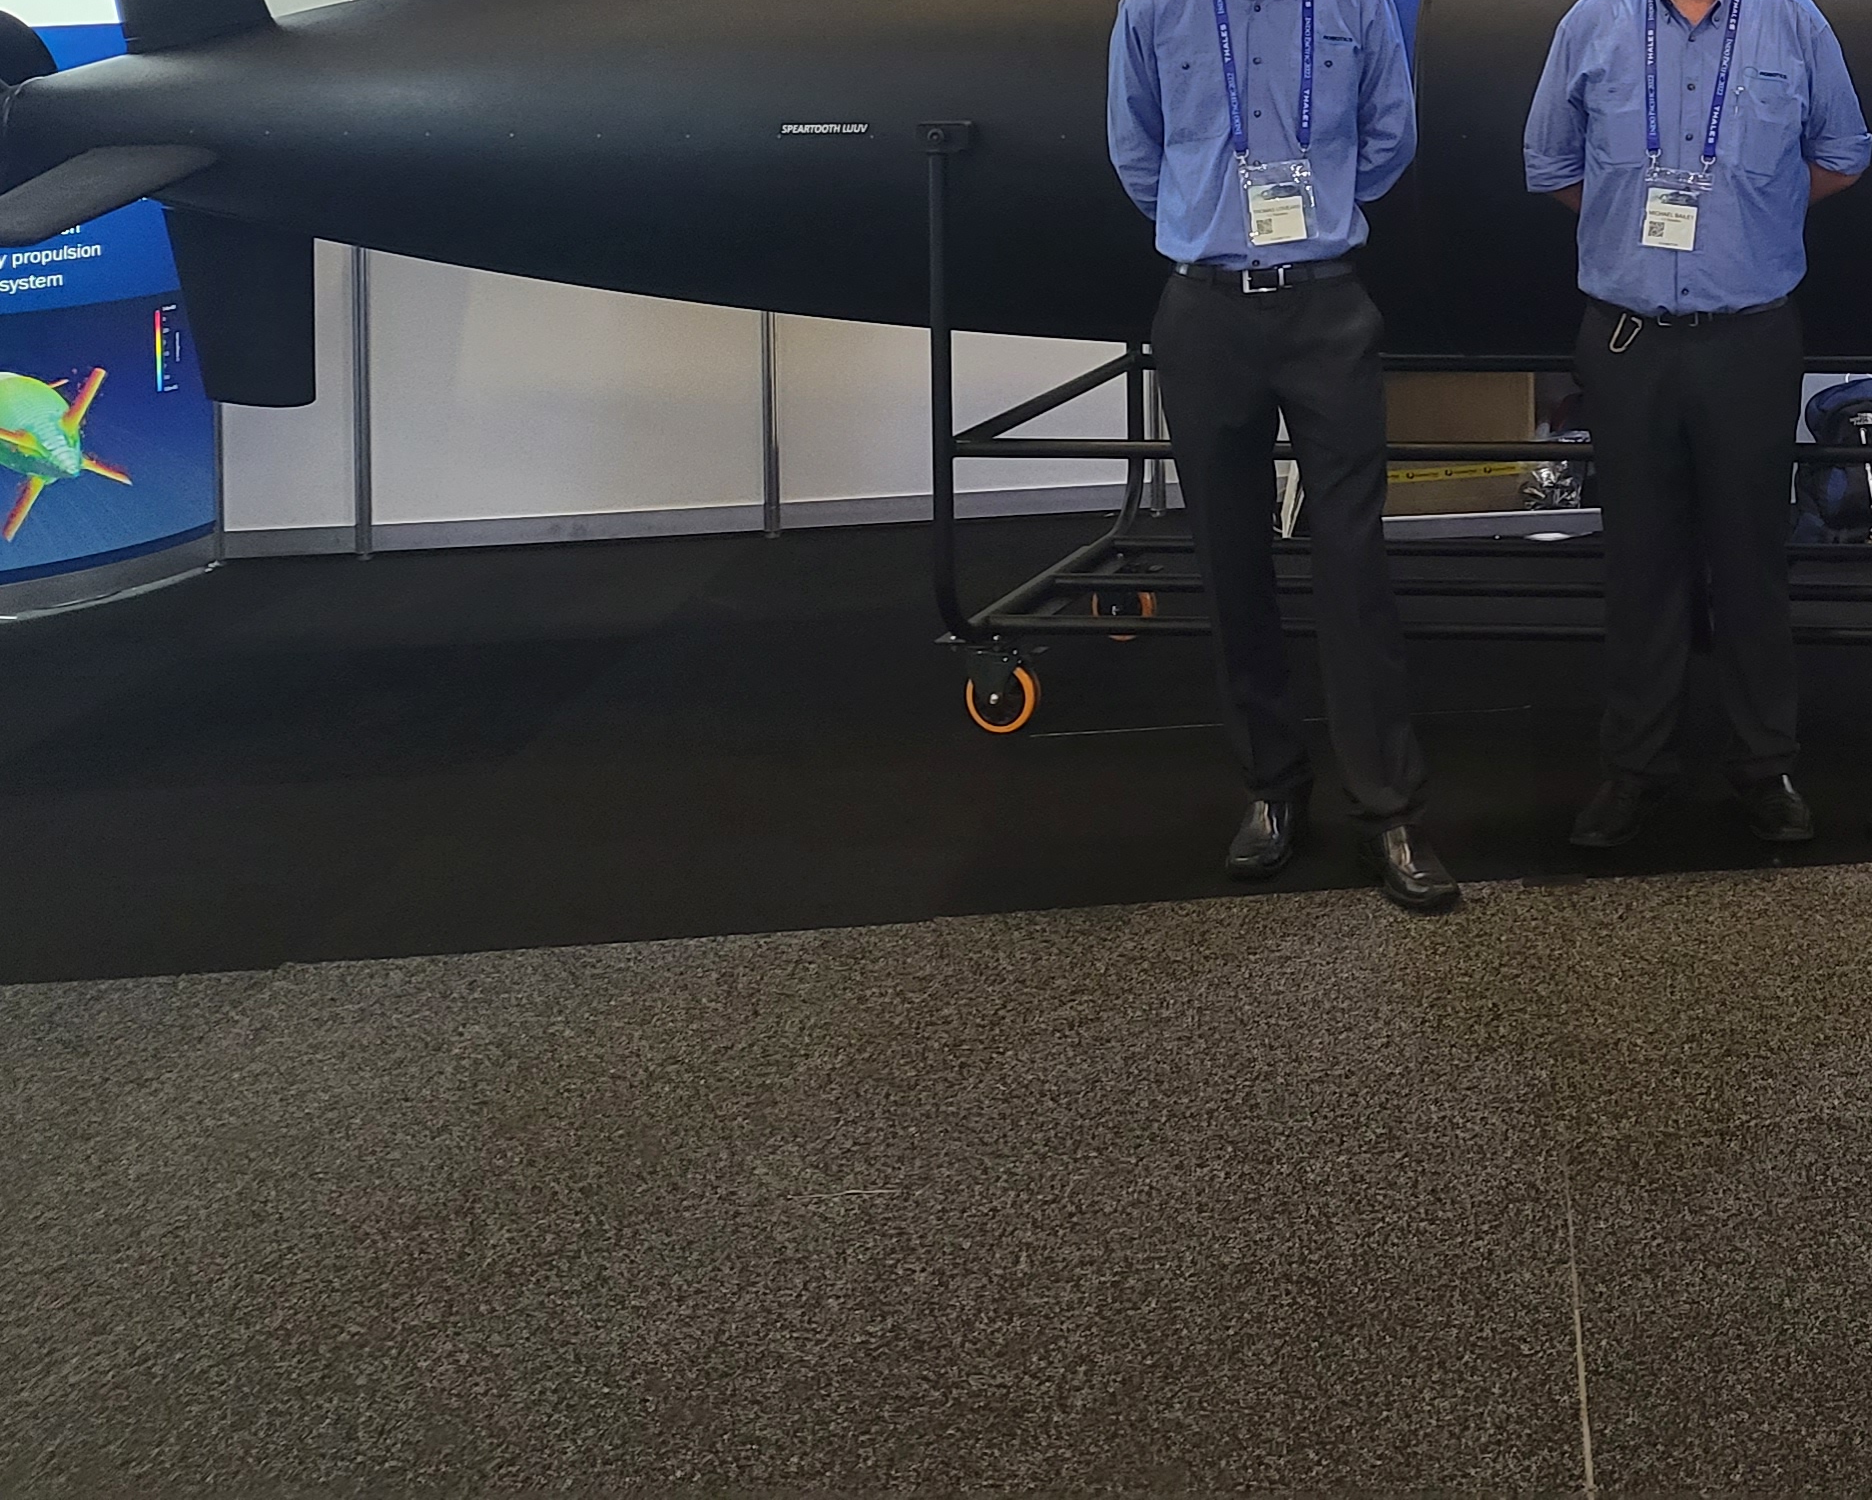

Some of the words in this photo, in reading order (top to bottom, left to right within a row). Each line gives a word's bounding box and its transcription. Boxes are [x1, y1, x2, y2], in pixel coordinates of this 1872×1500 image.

[1220, 23, 1231, 63] THALES
[1301, 88, 1310, 128] THALES
[781, 124, 840, 134] SPEARTOOTH
[1708, 106, 1721, 144] THALES
[12, 244, 101, 268] propulsion
[0, 274, 64, 295] system
